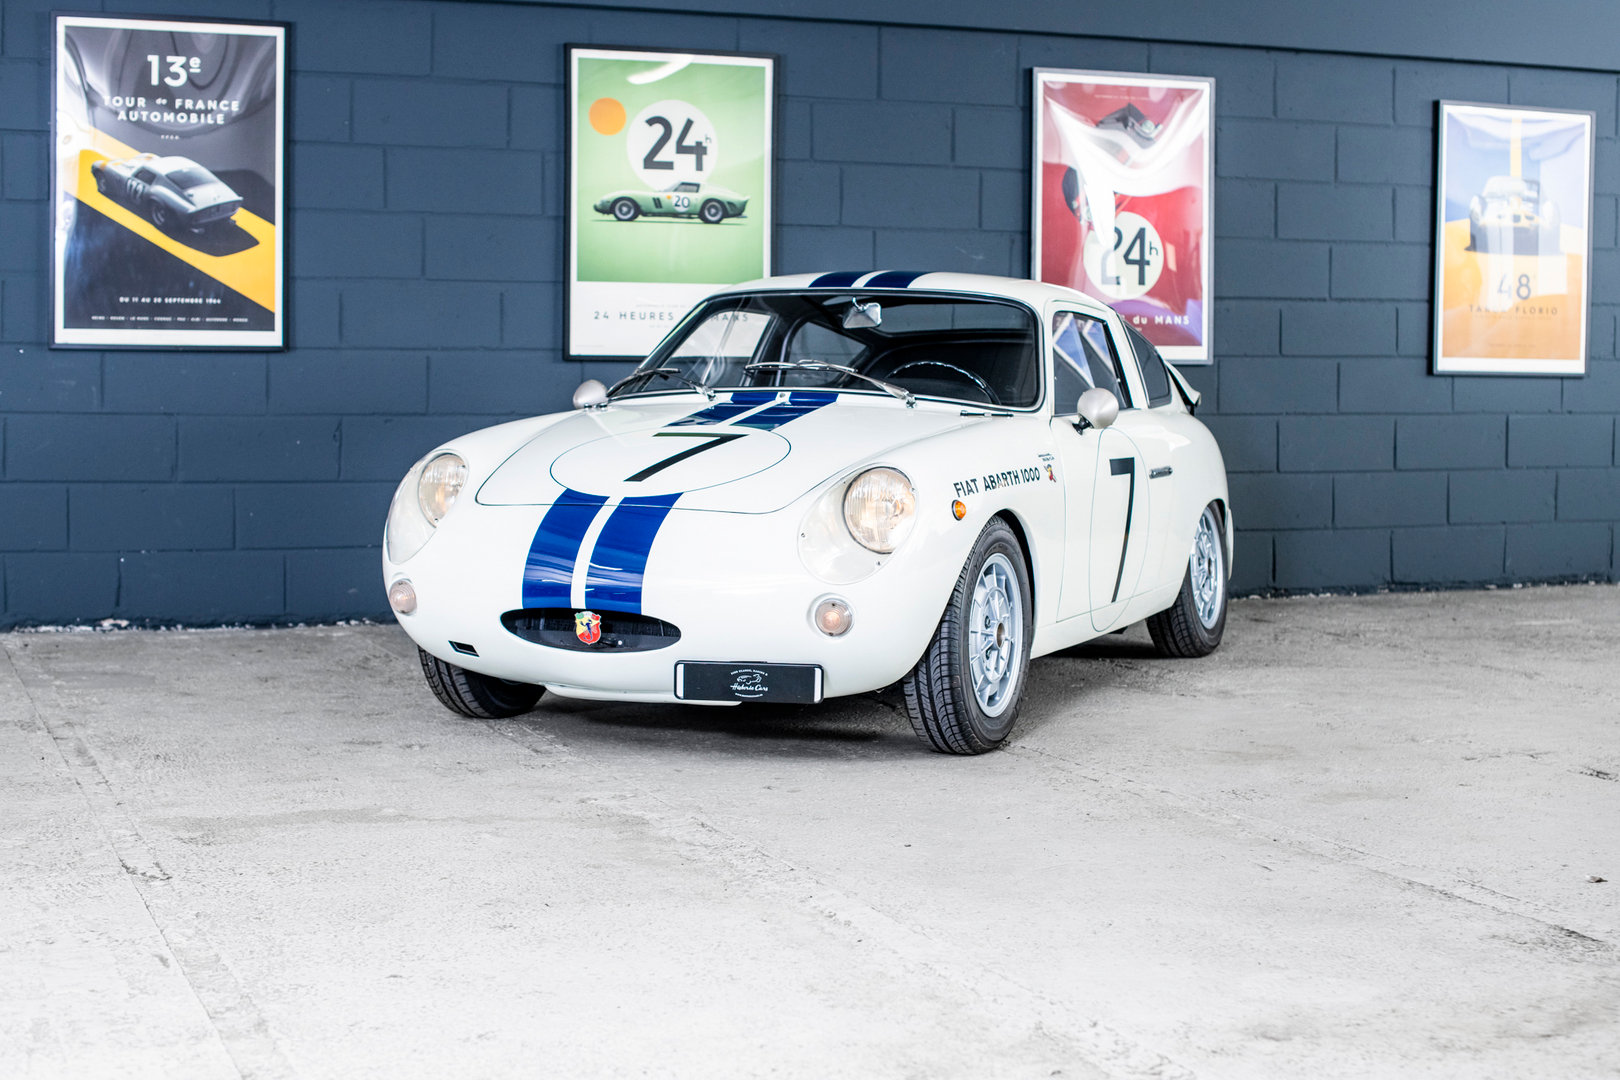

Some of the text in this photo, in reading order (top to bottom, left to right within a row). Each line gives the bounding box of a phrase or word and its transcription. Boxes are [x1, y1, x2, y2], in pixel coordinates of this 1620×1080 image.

[103, 95, 146, 108] TOUR
[175, 98, 239, 111] FRANCE
[117, 110, 225, 124] AUTOMOBILE
[674, 195, 690, 208] 20
[594, 311, 609, 320] 24
[619, 311, 674, 320] HEURES
[1515, 306, 1558, 315] FLORIO
[1133, 315, 1148, 325] du
[1154, 315, 1190, 325] MANS
[623, 432, 750, 482] 7
[953, 467, 1040, 498] FIAT ABARTH 1000
[1109, 457, 1135, 603] 7
